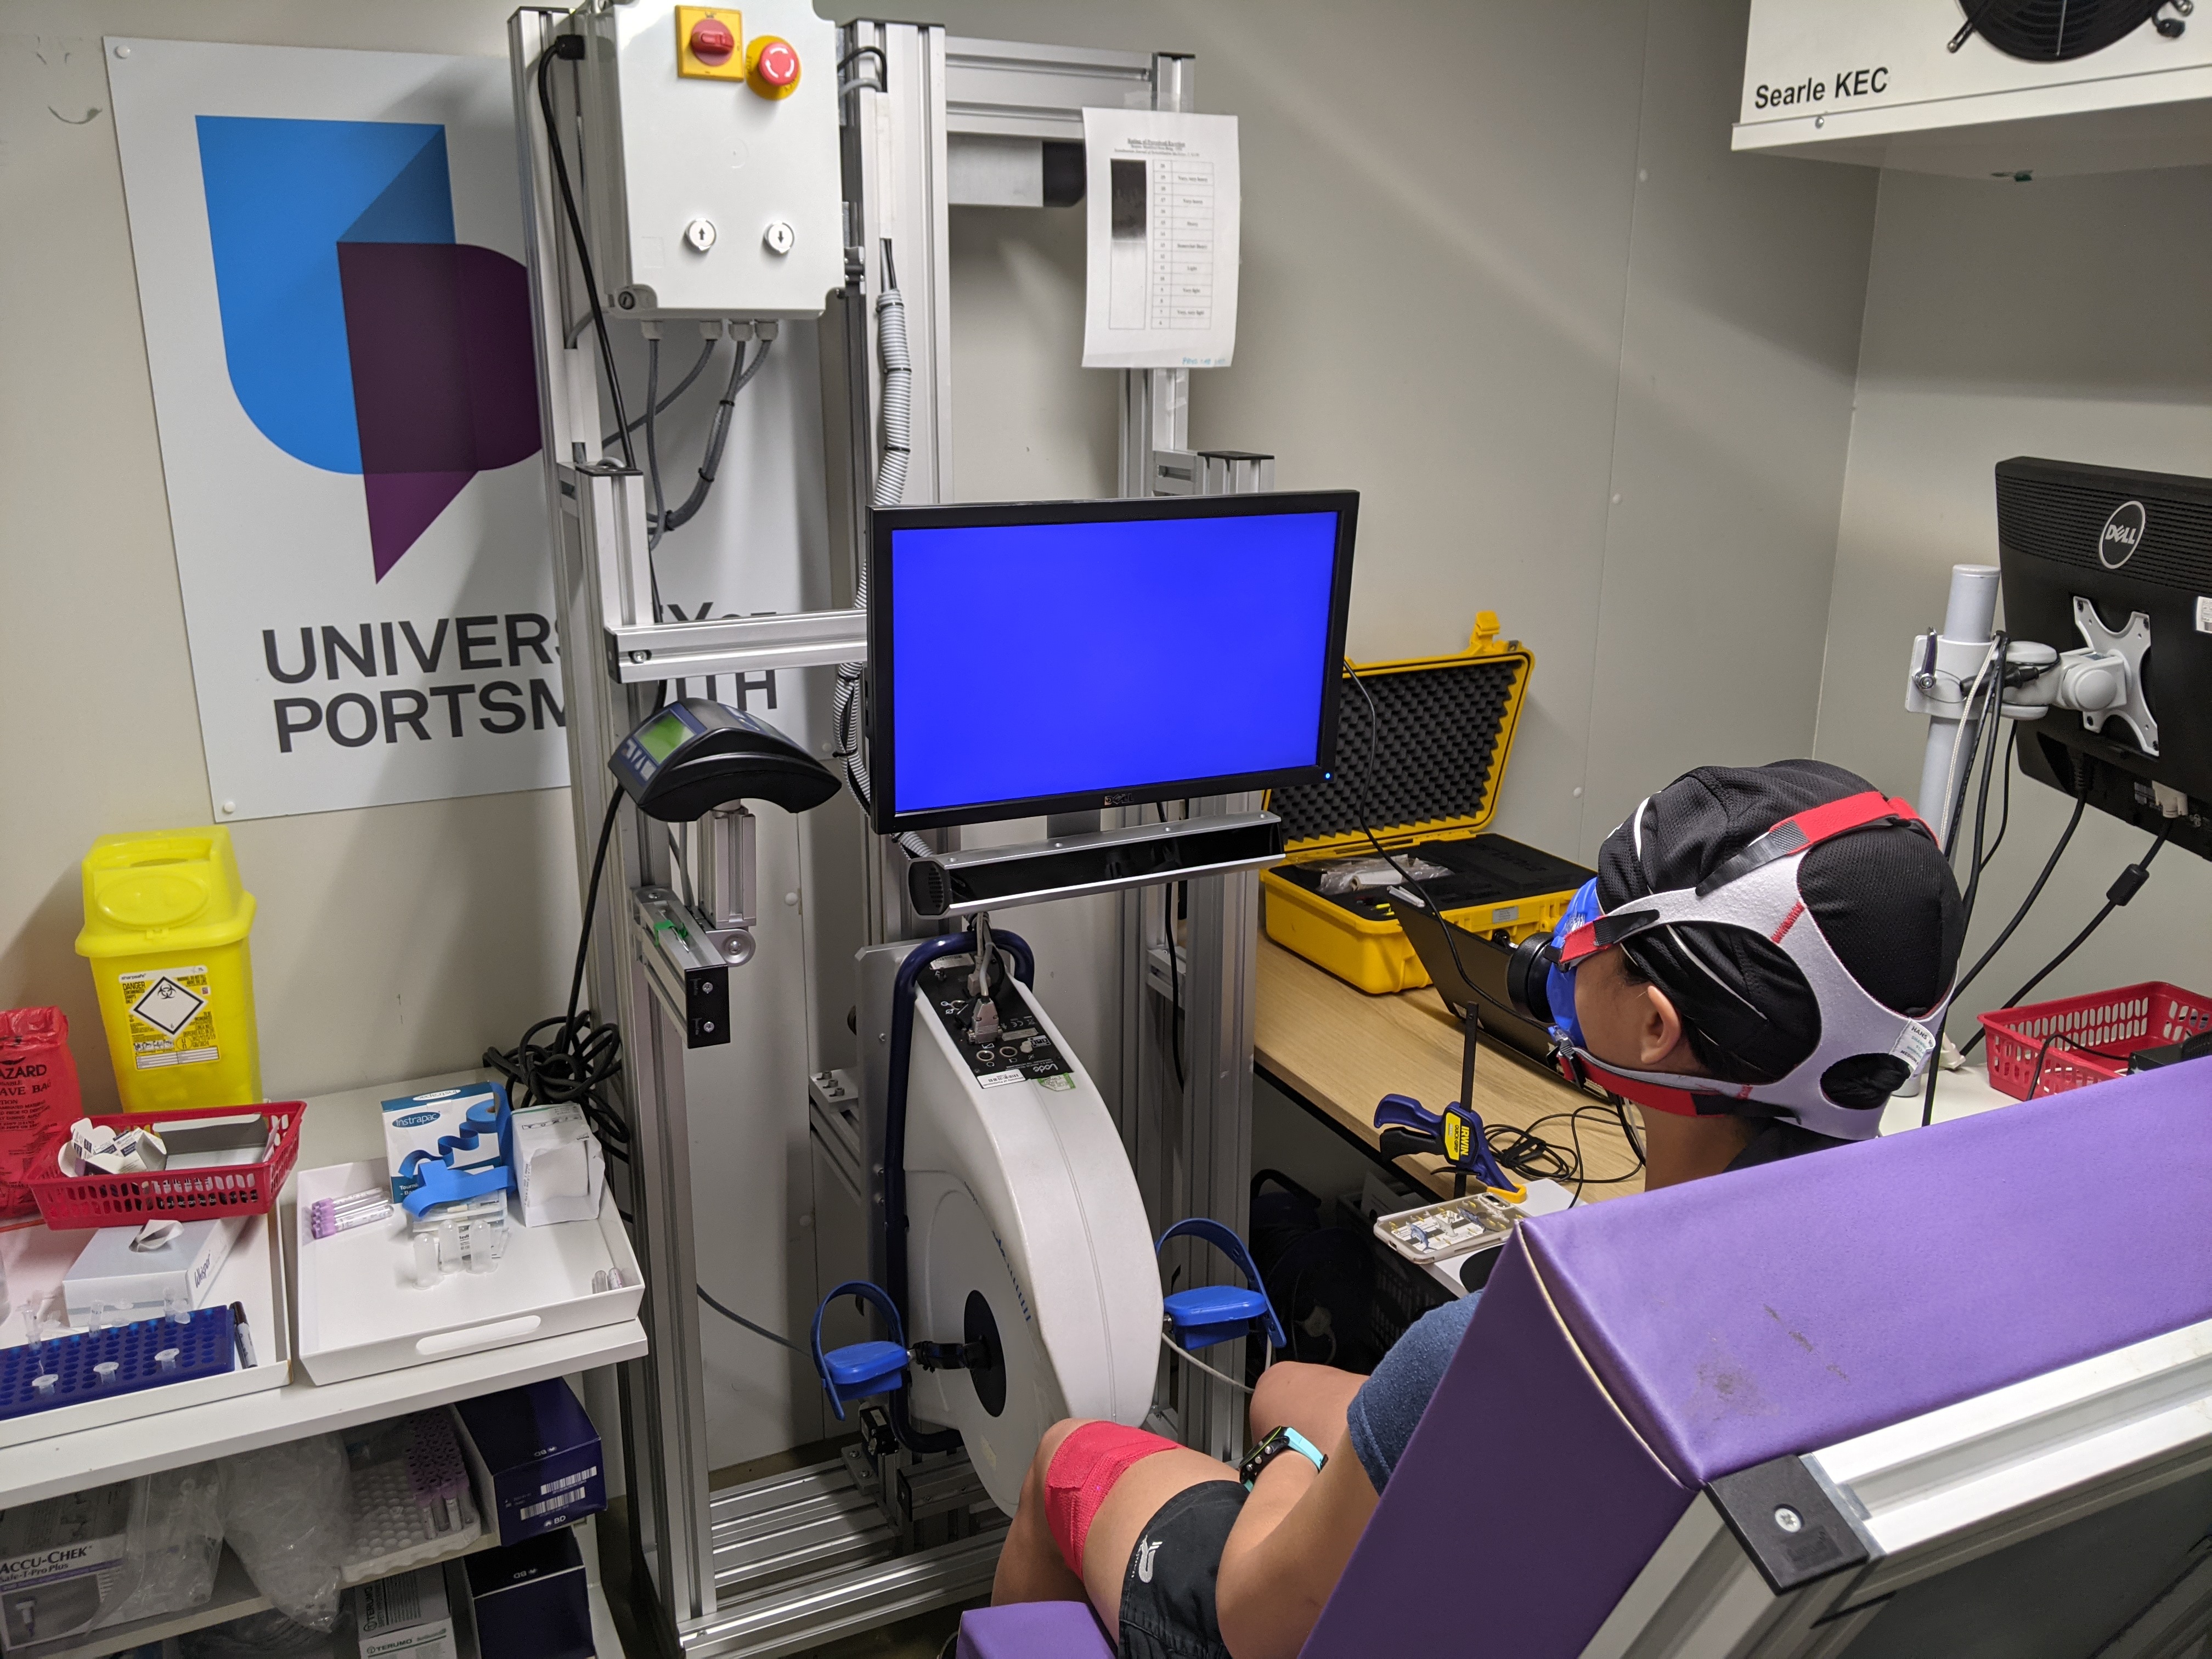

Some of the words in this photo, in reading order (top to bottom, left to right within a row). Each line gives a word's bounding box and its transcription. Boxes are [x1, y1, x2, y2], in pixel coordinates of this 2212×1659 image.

[1755, 82, 1826, 109] Searle
[1833, 66, 1889, 99] KEC
[2105, 524, 2137, 544] DELL
[1104, 793, 1135, 806] DELL
[122, 981, 146, 991] DANGER
[1911, 1026, 1928, 1040] HANS
[1900, 1049, 1917, 1063] MEDIUM
[396, 1113, 438, 1127] Instrapac
[1460, 1125, 1470, 1156] IRWIN
[194, 1254, 210, 1289] Whisper
[554, 1515, 566, 1524] BD
[0, 1546, 88, 1574] ACCU-CHEK
[49, 1563, 69, 1572] Plus
[375, 1639, 412, 1651] TERUMO
